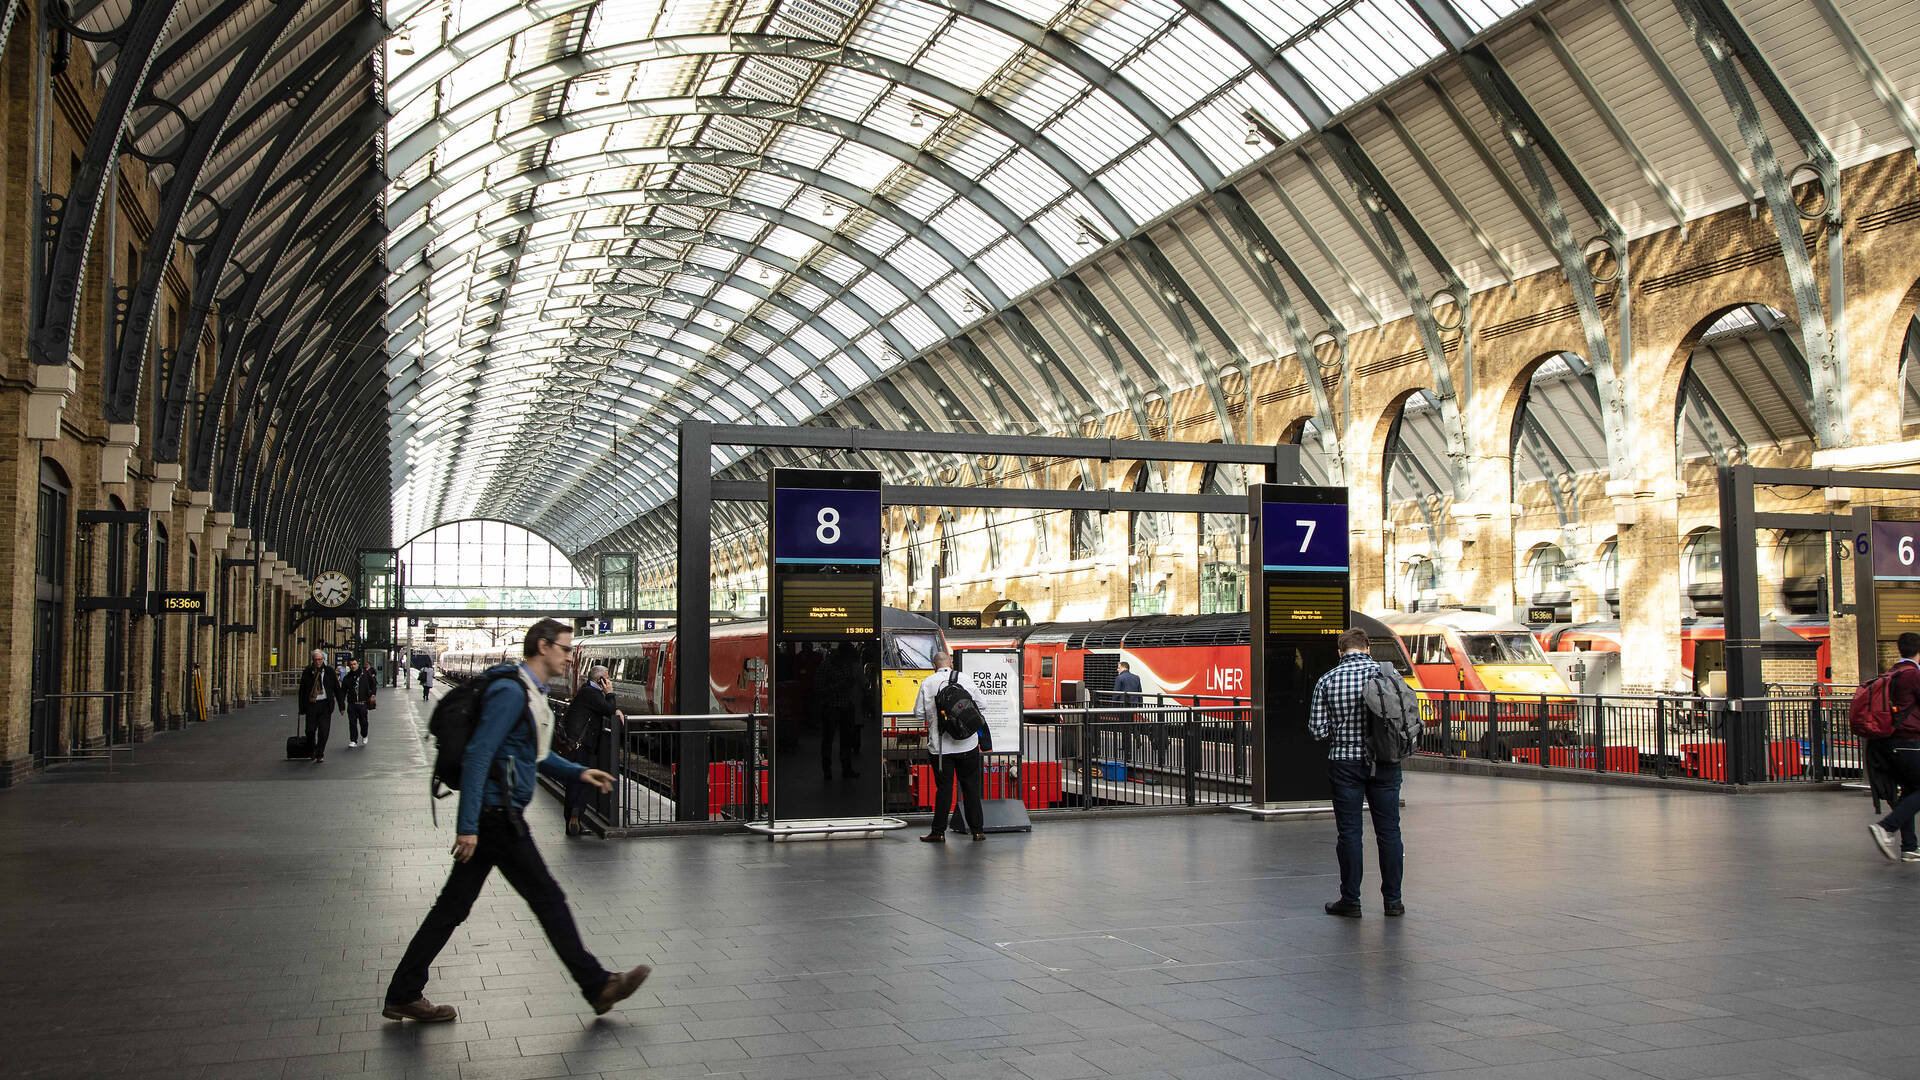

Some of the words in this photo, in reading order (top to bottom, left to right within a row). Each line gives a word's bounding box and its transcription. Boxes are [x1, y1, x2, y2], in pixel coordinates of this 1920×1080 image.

[816, 507, 840, 544] 8
[1251, 516, 1259, 542] 7
[1296, 520, 1317, 553] 7
[1856, 533, 1869, 555] 6
[1898, 536, 1915, 566] 6
[973, 672, 992, 680] FOR
[994, 672, 1008, 680] AN
[1206, 663, 1244, 695] LNER
